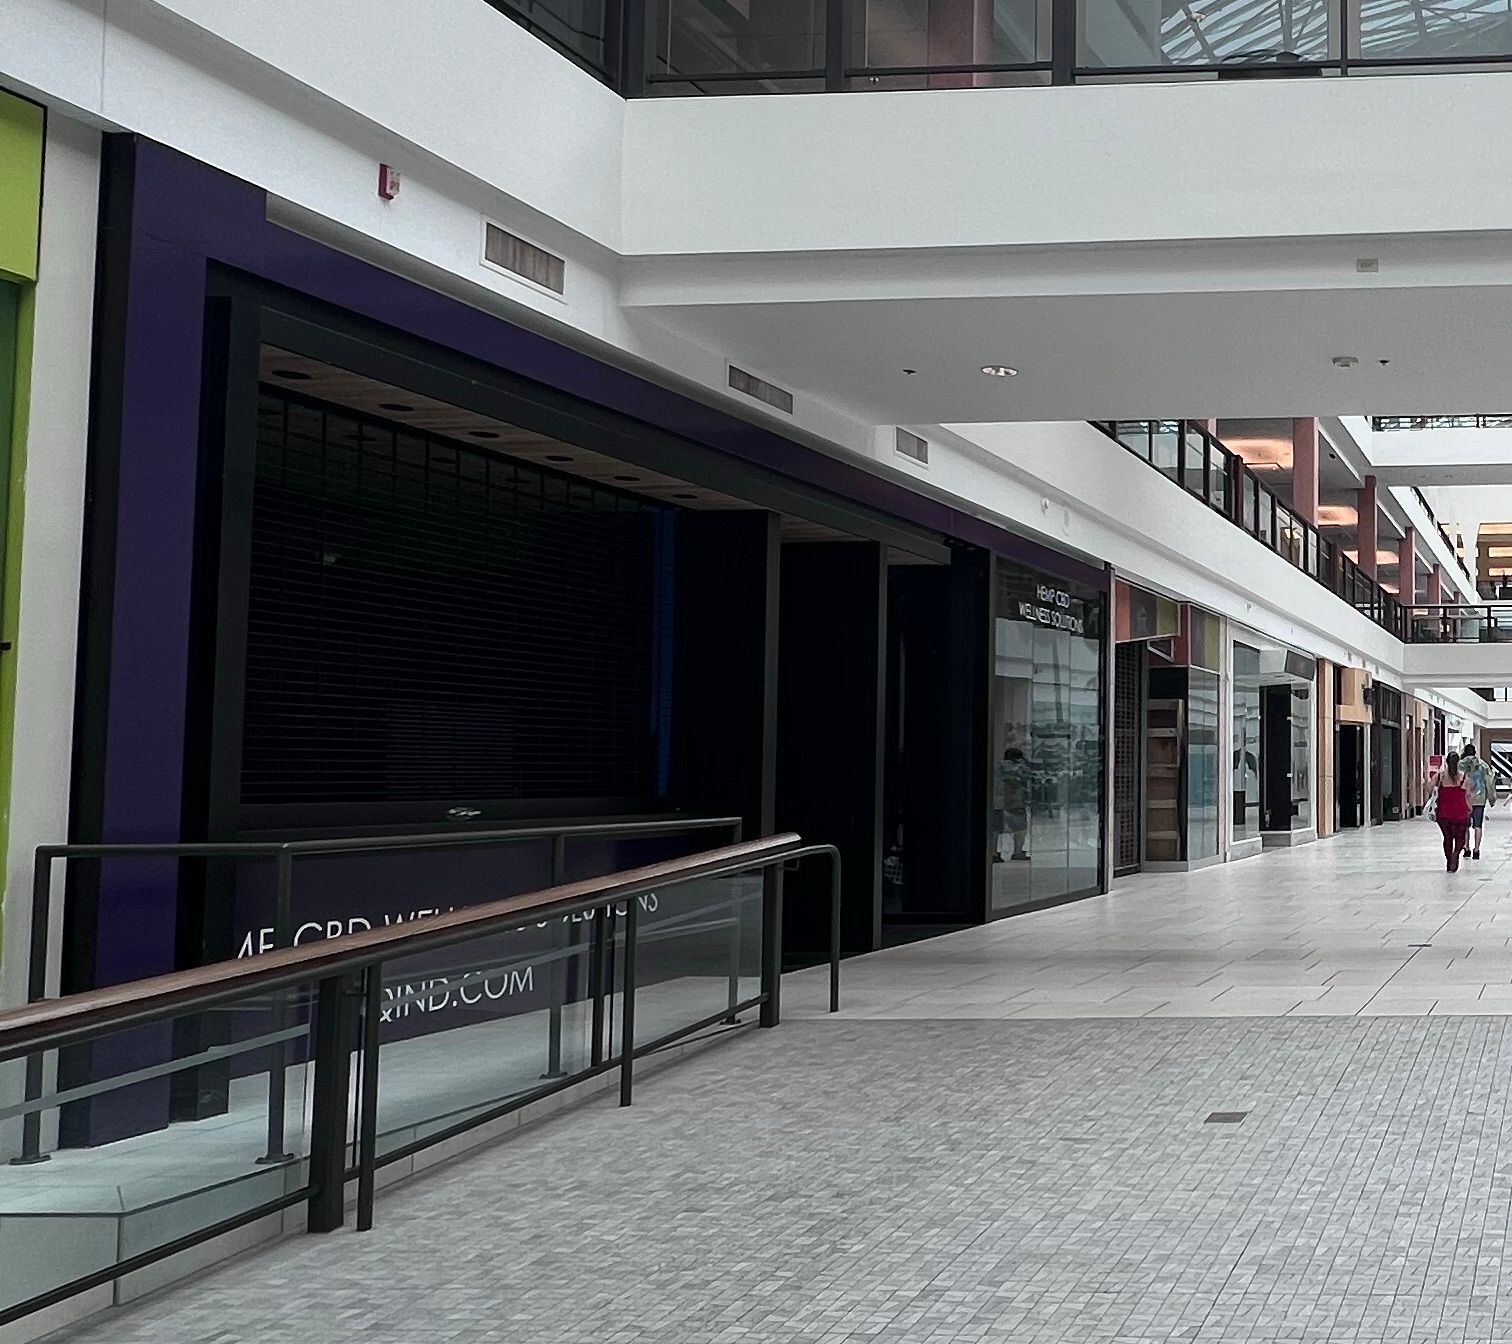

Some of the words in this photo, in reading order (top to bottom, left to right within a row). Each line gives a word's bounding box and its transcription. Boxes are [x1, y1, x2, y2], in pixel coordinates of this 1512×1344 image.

[1037, 583, 1055, 603] HEMP
[1056, 590, 1071, 609] CBD
[1018, 601, 1050, 624] WELLNESS
[1051, 610, 1084, 634] SOLUTIONS
